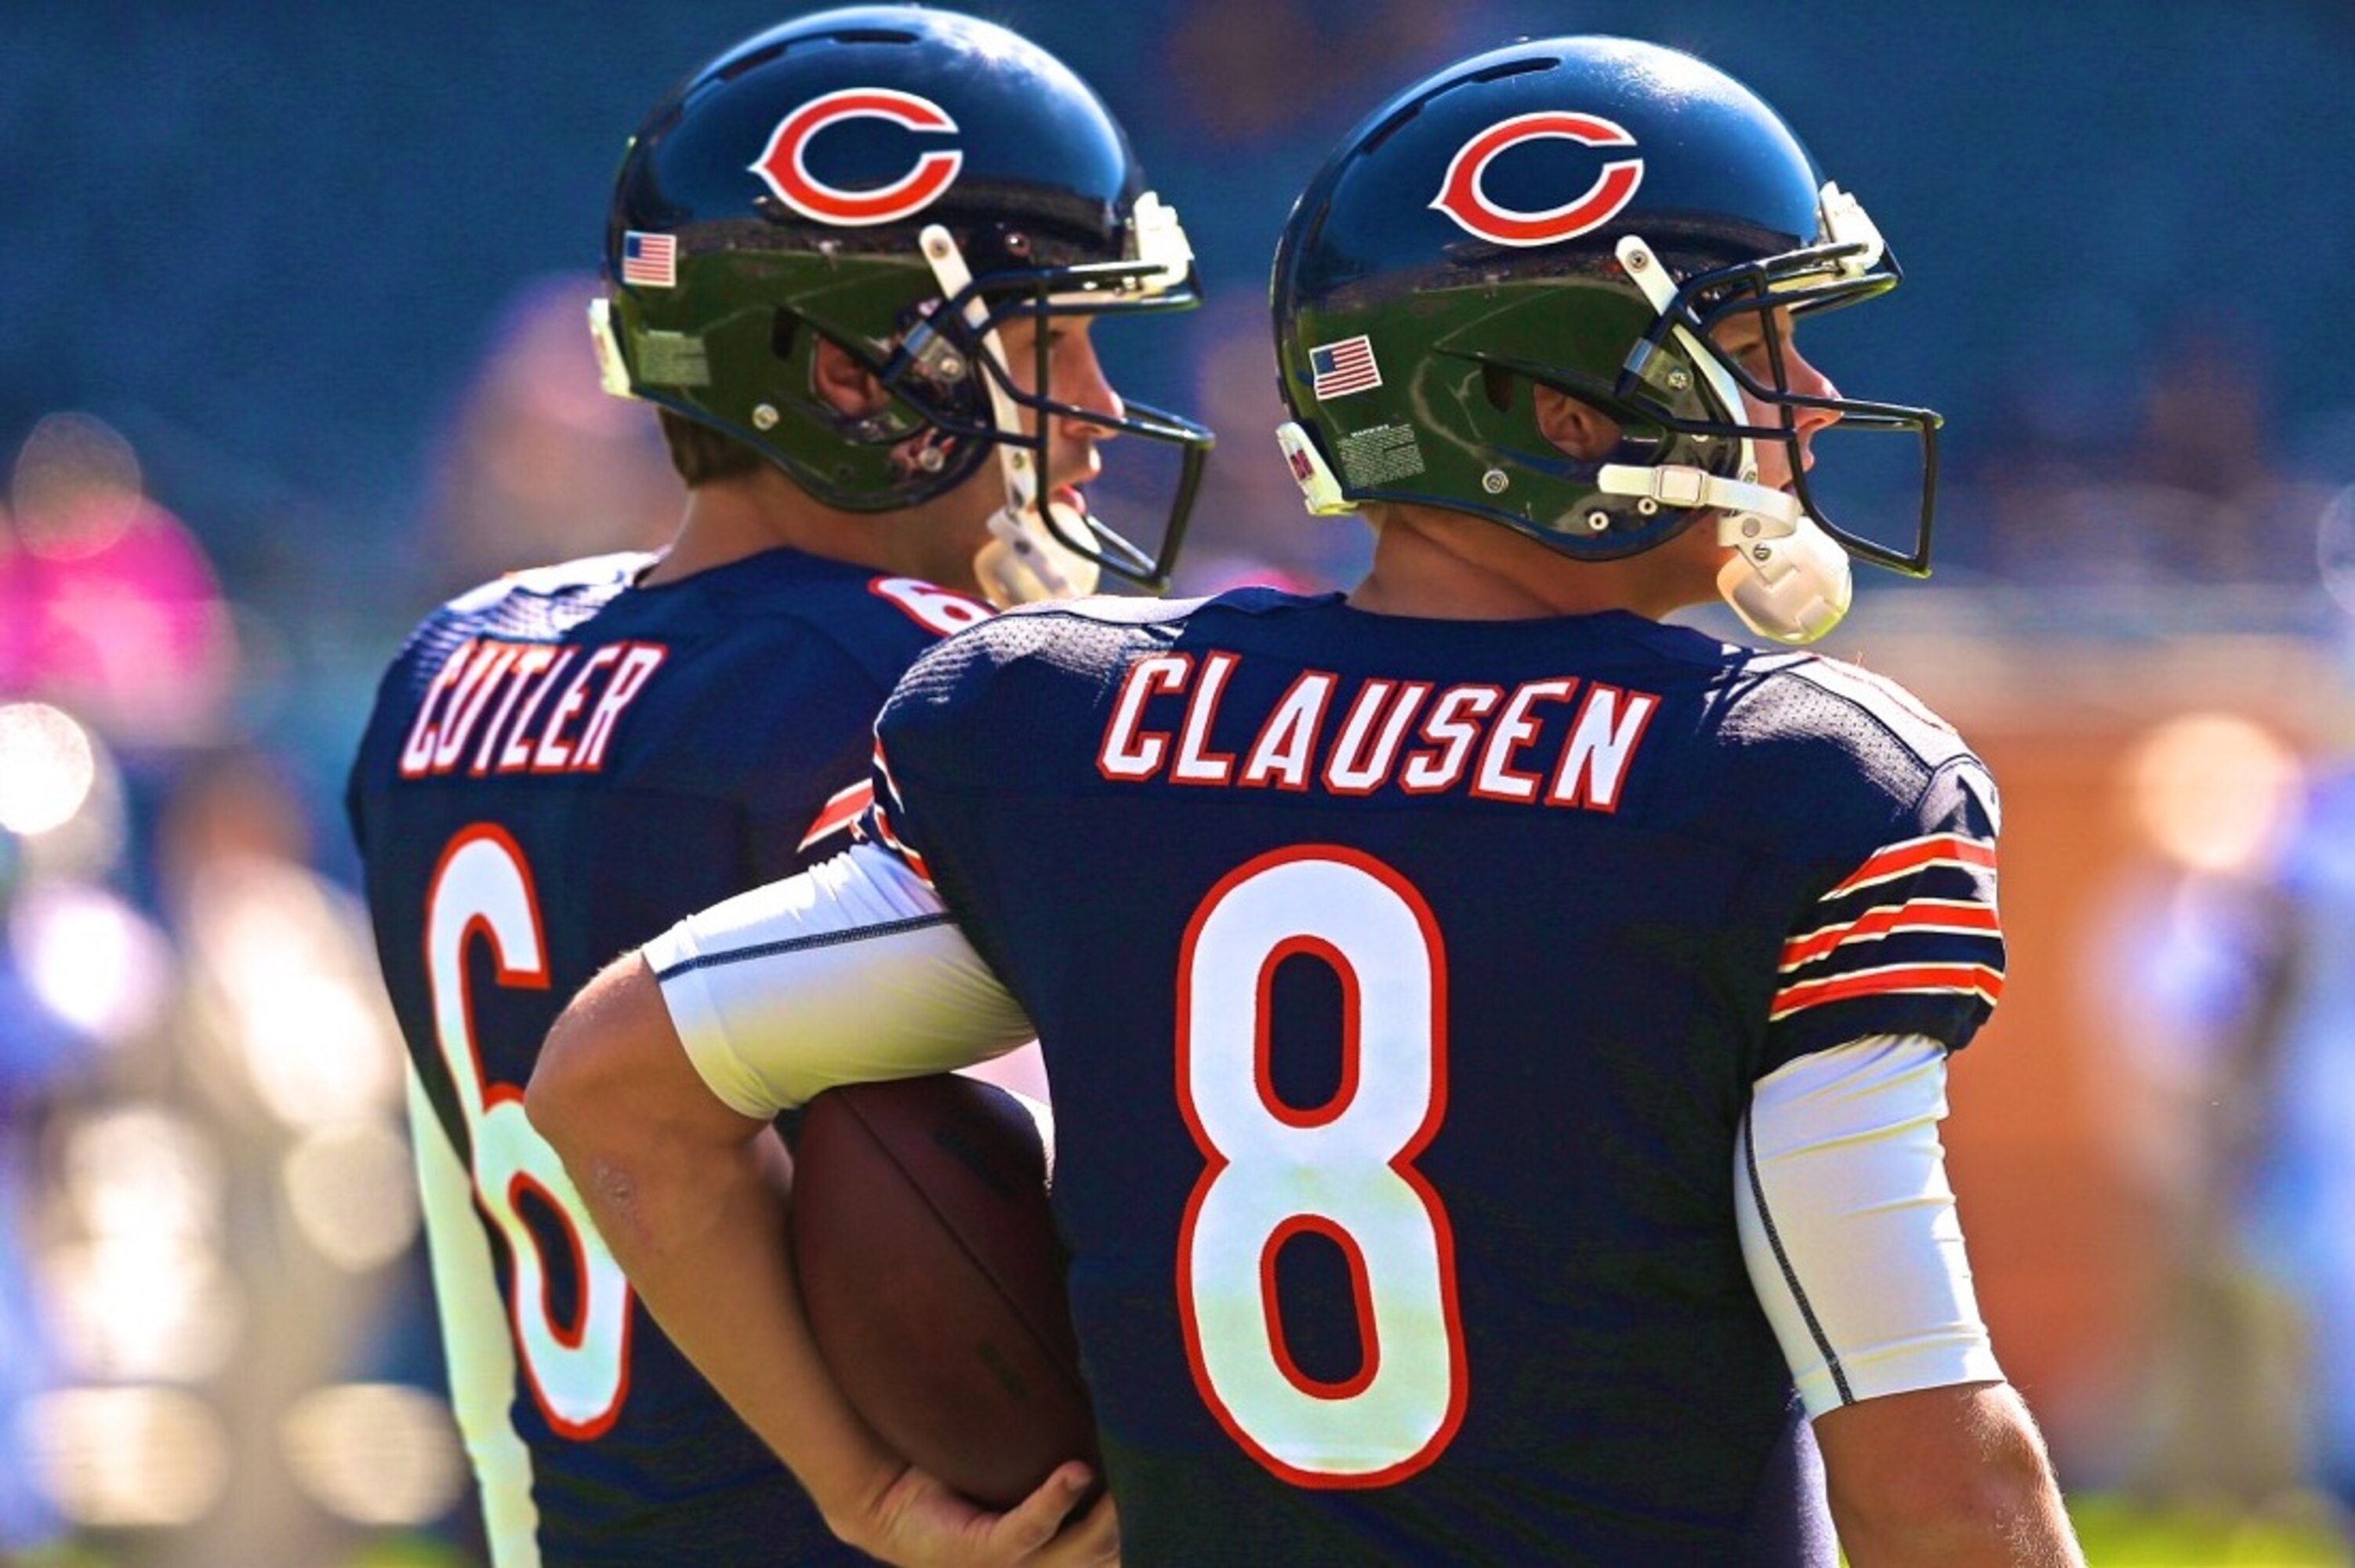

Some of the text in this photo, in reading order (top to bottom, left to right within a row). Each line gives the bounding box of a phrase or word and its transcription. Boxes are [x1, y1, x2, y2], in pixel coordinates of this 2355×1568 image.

[747, 87, 963, 227] C
[1427, 111, 1645, 247] C
[401, 638, 669, 779] CUTLER
[1097, 648, 1661, 813] CLAUSEN
[425, 822, 633, 1441] 6
[1175, 844, 1468, 1489] 8
